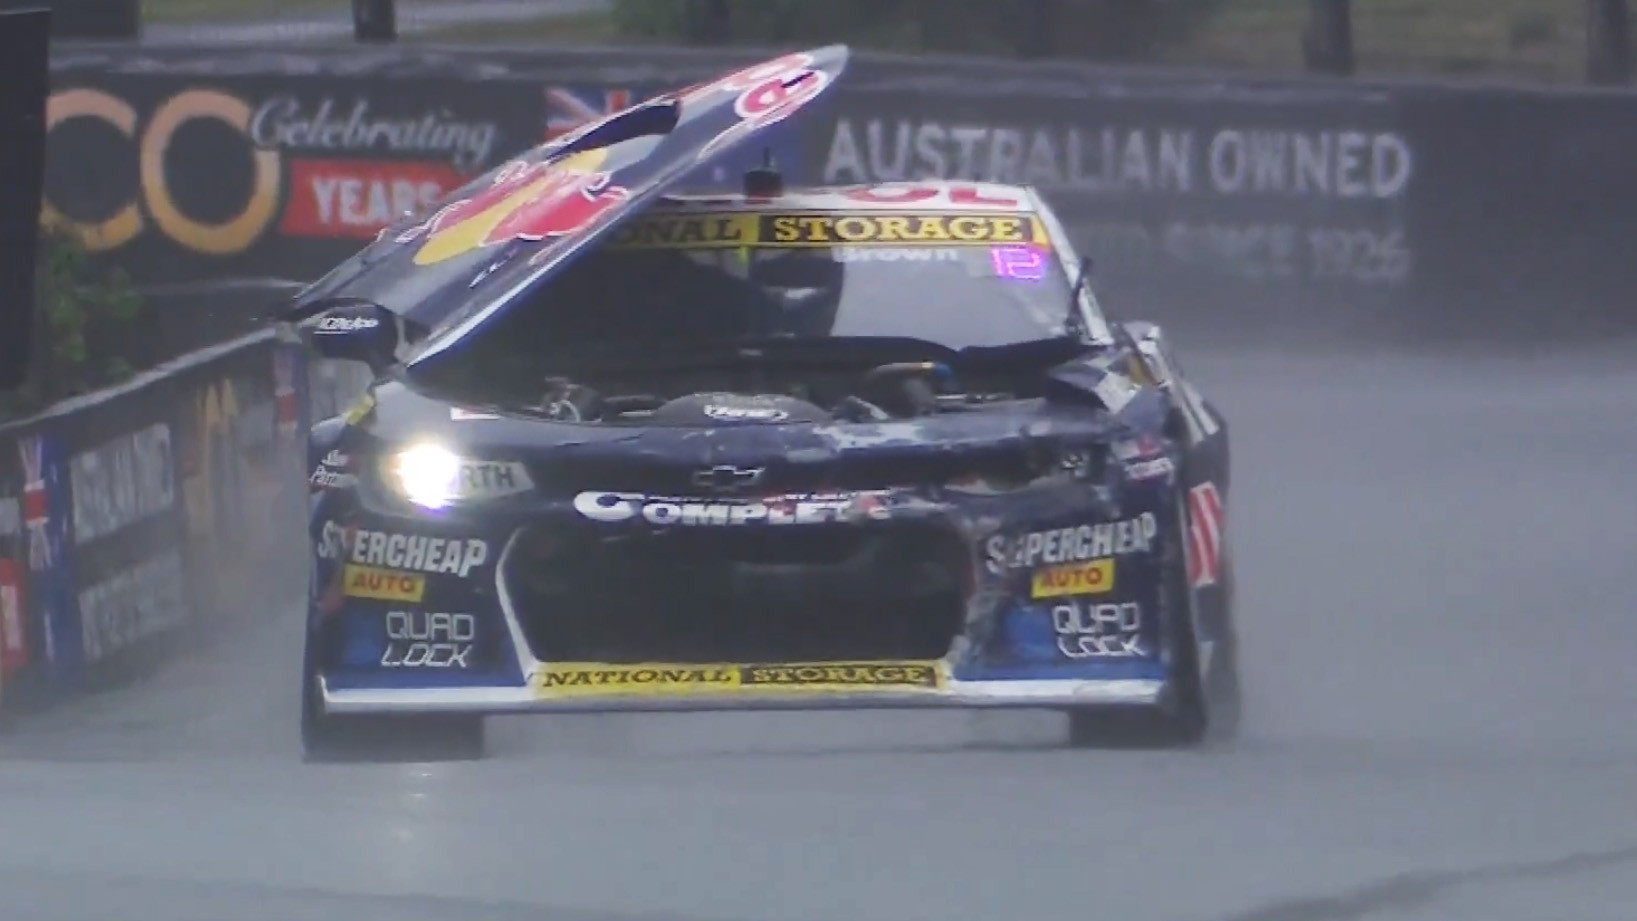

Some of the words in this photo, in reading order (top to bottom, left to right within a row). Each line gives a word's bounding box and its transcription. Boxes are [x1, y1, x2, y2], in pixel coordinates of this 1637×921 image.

[250, 98, 496, 168] Celebrating
[823, 119, 1193, 192] AUSTRALIAN
[1209, 129, 1413, 197] OWNED
[608, 216, 743, 243] ONAL
[774, 215, 1024, 243] STORAGE
[991, 246, 1043, 280] 12
[460, 462, 516, 489] RTH
[352, 570, 416, 593] AUTO
[1040, 566, 1103, 588] AUTO
[386, 610, 475, 641] QUAD
[380, 642, 474, 668] LOCK
[1055, 632, 1148, 659] LOCK
[541, 667, 734, 689] NATIONAL
[752, 664, 932, 686] STORAGE
